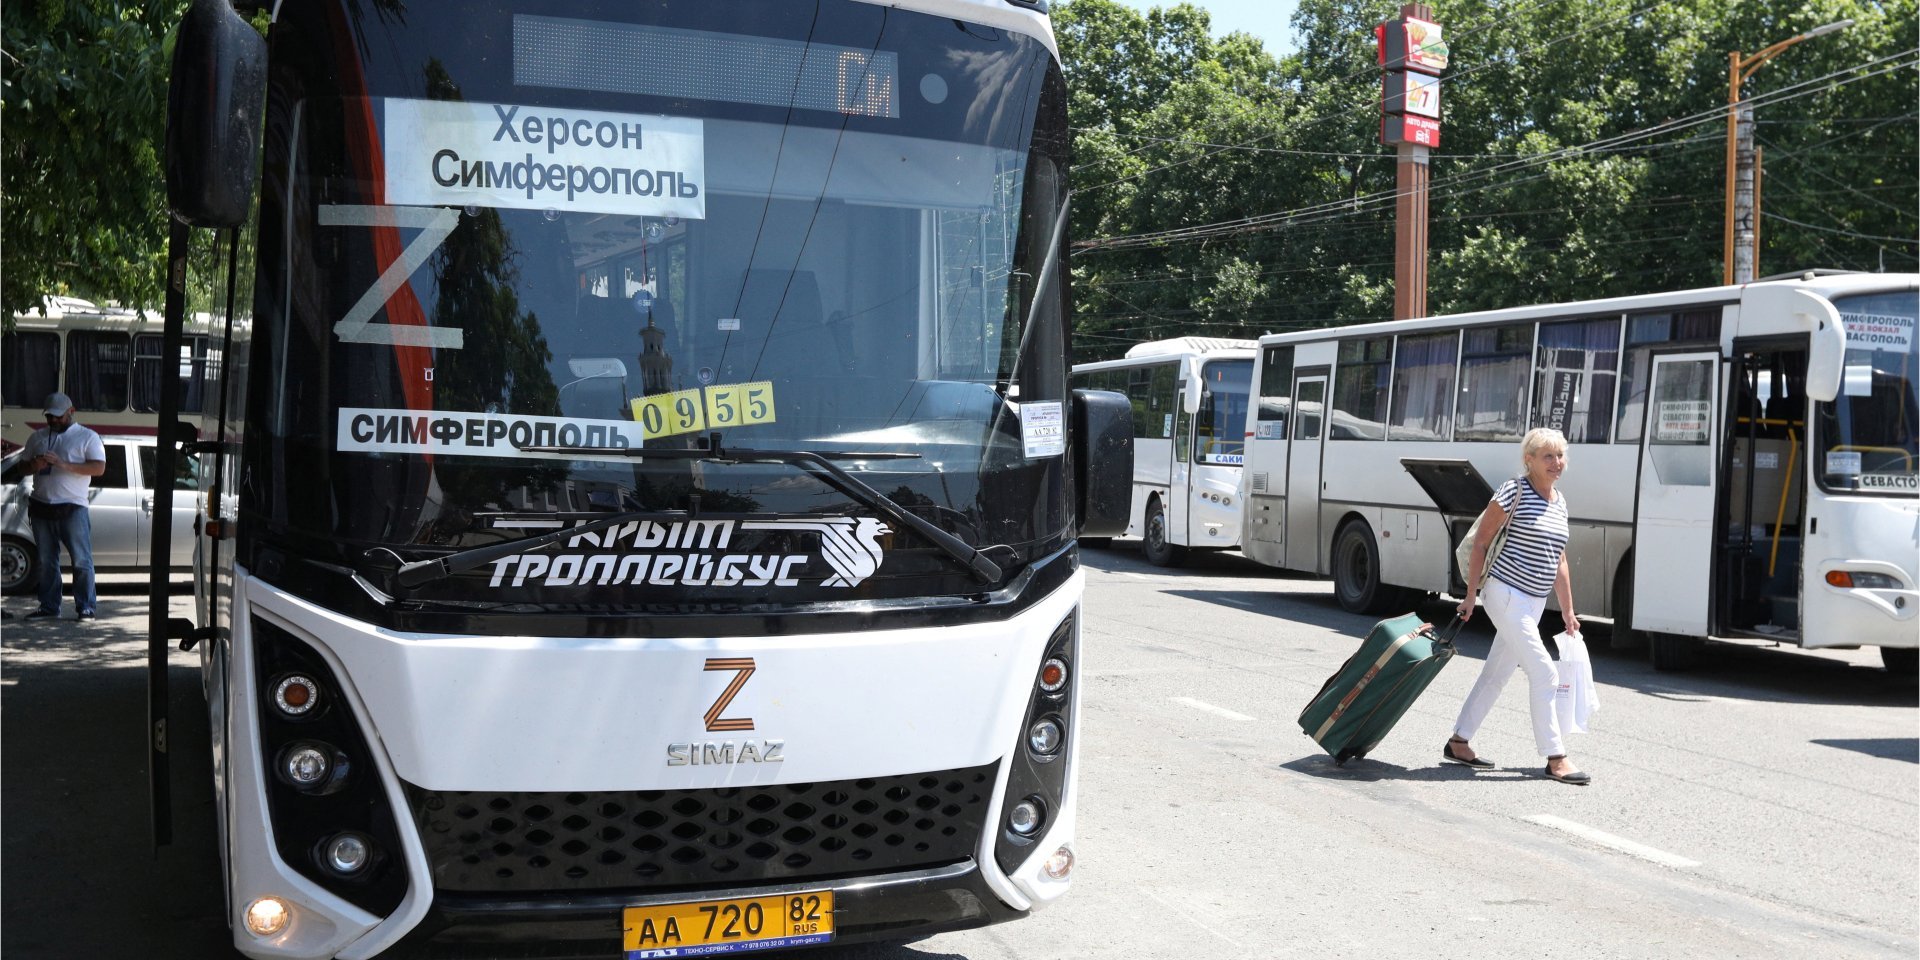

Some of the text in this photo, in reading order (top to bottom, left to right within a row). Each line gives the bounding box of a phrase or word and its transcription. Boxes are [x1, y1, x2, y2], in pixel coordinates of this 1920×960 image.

[838, 51, 890, 117] Си
[492, 104, 642, 154] Херсон
[432, 149, 699, 201] Симферополь
[317, 204, 464, 349] Z
[1846, 332, 1908, 345] ВАСТОПОЛЬ
[1867, 325, 1900, 334] ВОКЗАЛ
[350, 413, 630, 449] СИМФЕРОПОЛЬ
[1215, 455, 1243, 464] САКИ
[1862, 475, 1919, 489] СЕВАСТО
[568, 519, 735, 548] КРЫМ
[488, 554, 808, 587] ТРОЛЛЕЙБУС
[703, 657, 756, 732] Z
[667, 739, 785, 766] SIMAZ
[699, 902, 764, 940] 720
[789, 895, 821, 921] 82
[793, 923, 818, 935] RUS
